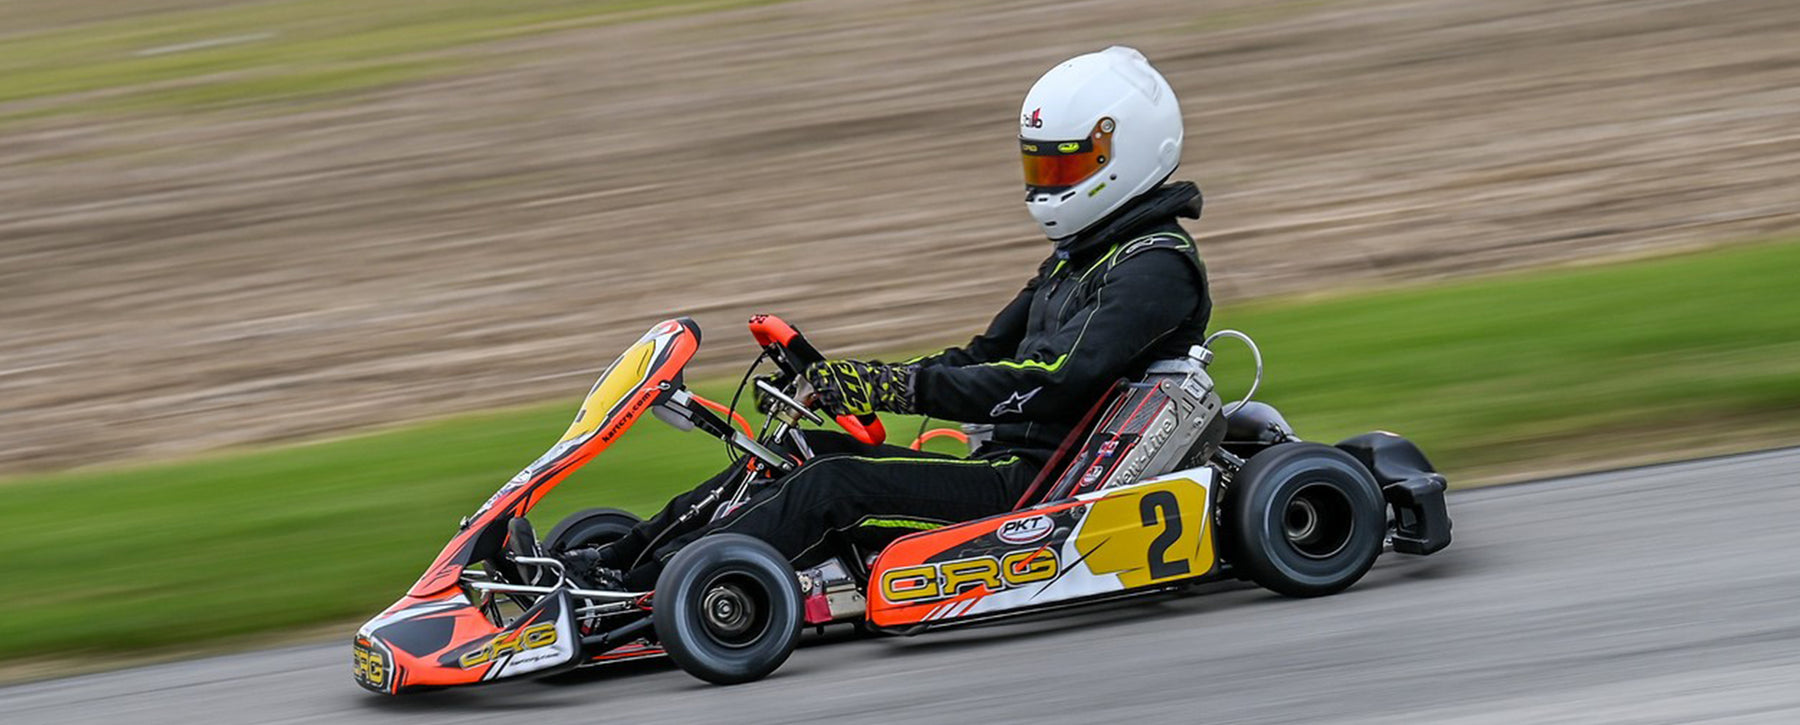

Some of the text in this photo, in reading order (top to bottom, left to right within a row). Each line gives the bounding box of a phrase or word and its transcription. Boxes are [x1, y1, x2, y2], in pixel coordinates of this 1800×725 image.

[602, 391, 651, 442] kartcrg.com
[1003, 516, 1043, 534] PKT
[1139, 490, 1191, 580] 2
[881, 547, 1060, 602] CRG
[460, 623, 557, 668] CRG
